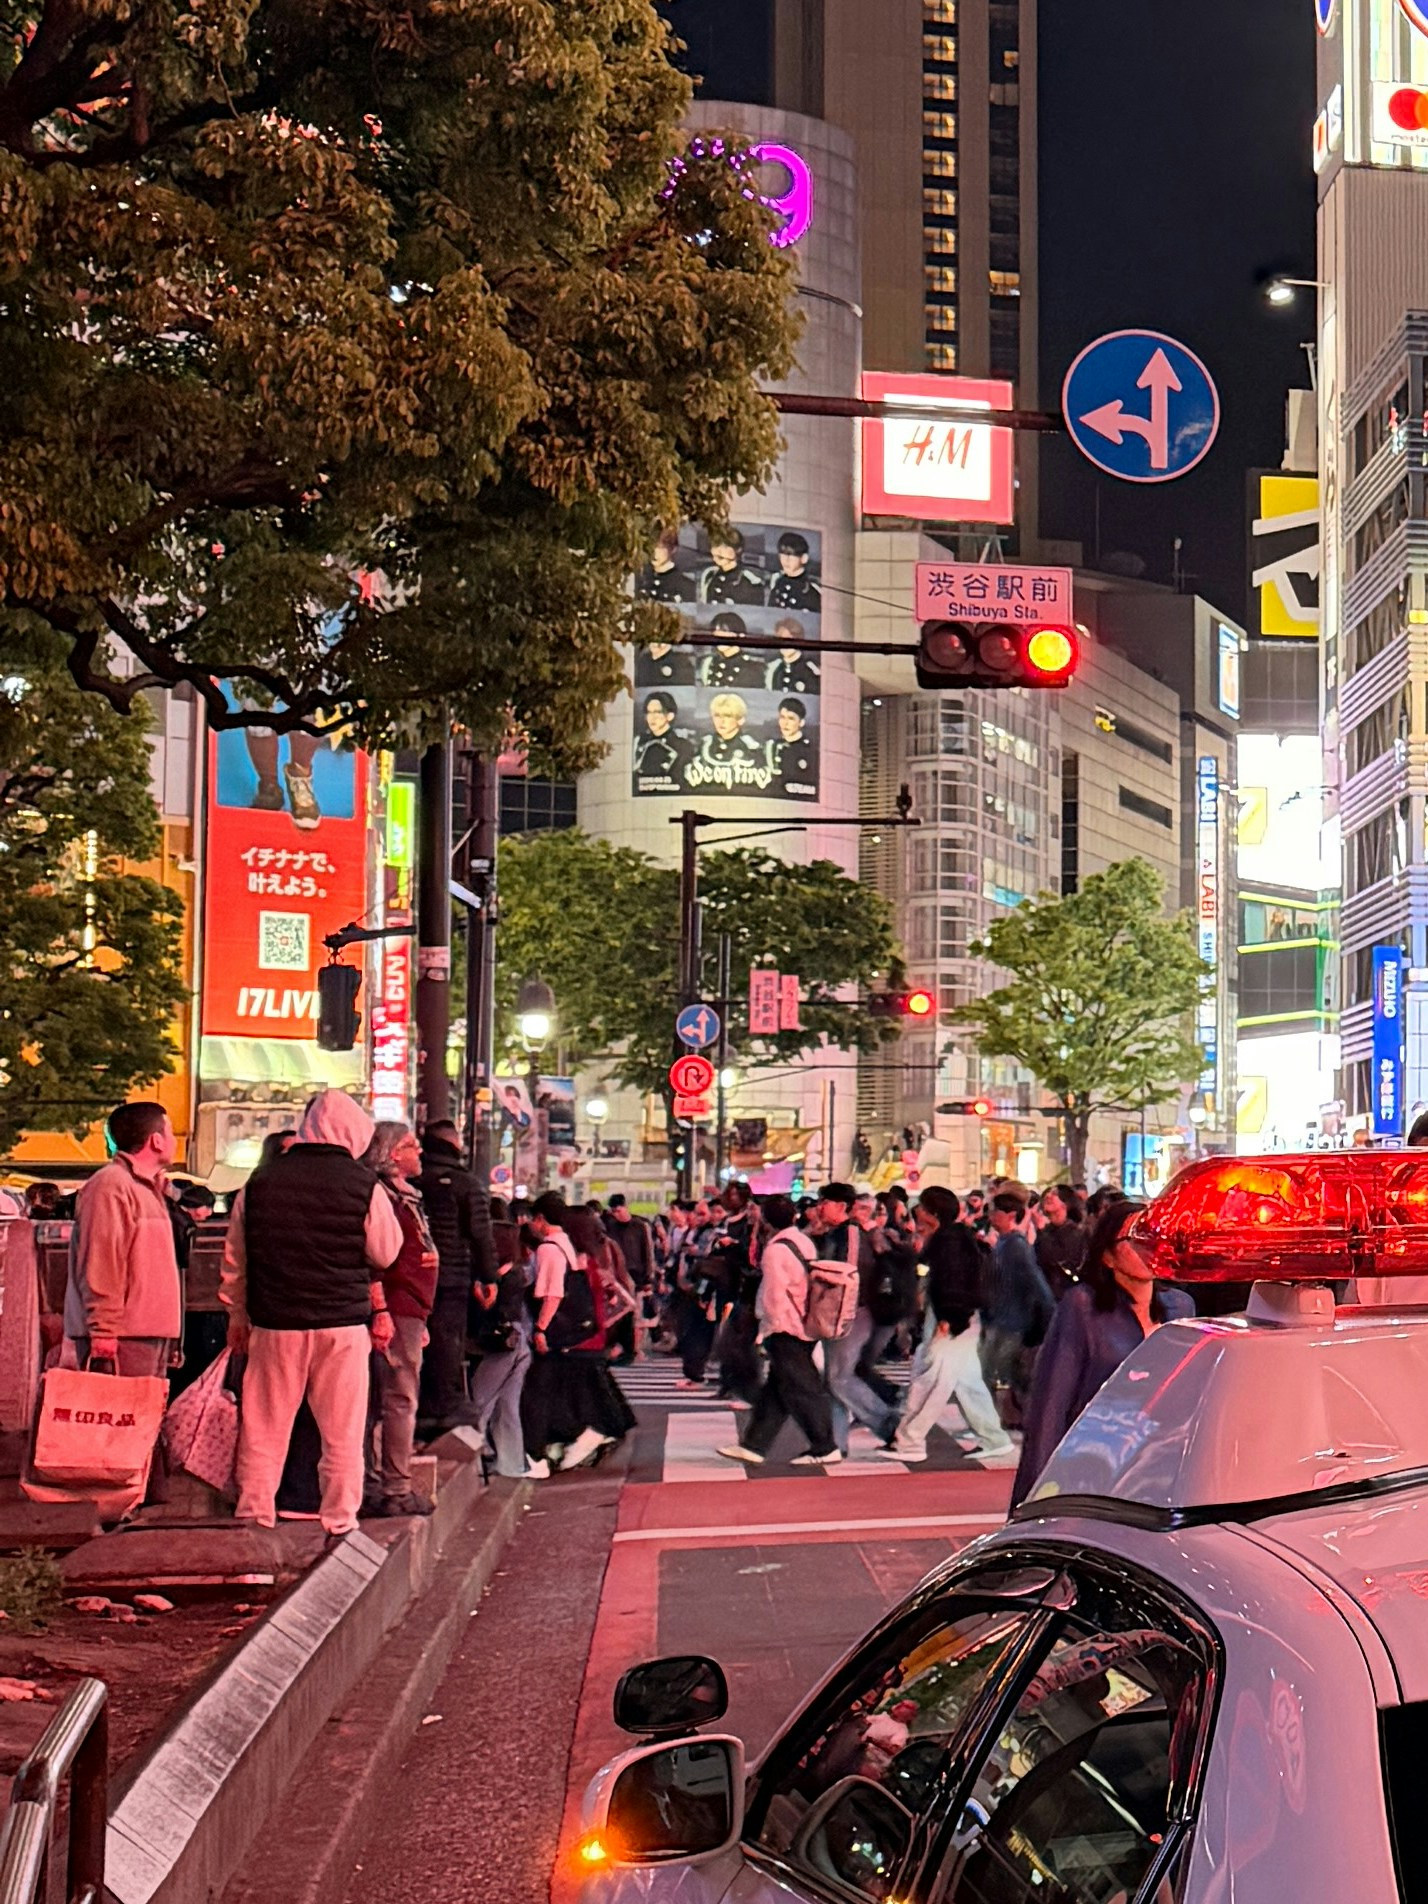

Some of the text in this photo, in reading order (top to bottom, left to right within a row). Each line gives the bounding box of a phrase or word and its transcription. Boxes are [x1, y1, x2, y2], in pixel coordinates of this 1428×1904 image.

[929, 571, 1059, 602] 渋谷駅前
[949, 603, 1008, 621] Shibuya
[240, 847, 337, 874] イチナナで、
[247, 872, 328, 899] 叶えよう。
[1200, 873, 1216, 920] LABI
[1383, 960, 1398, 1019] MIZUHO
